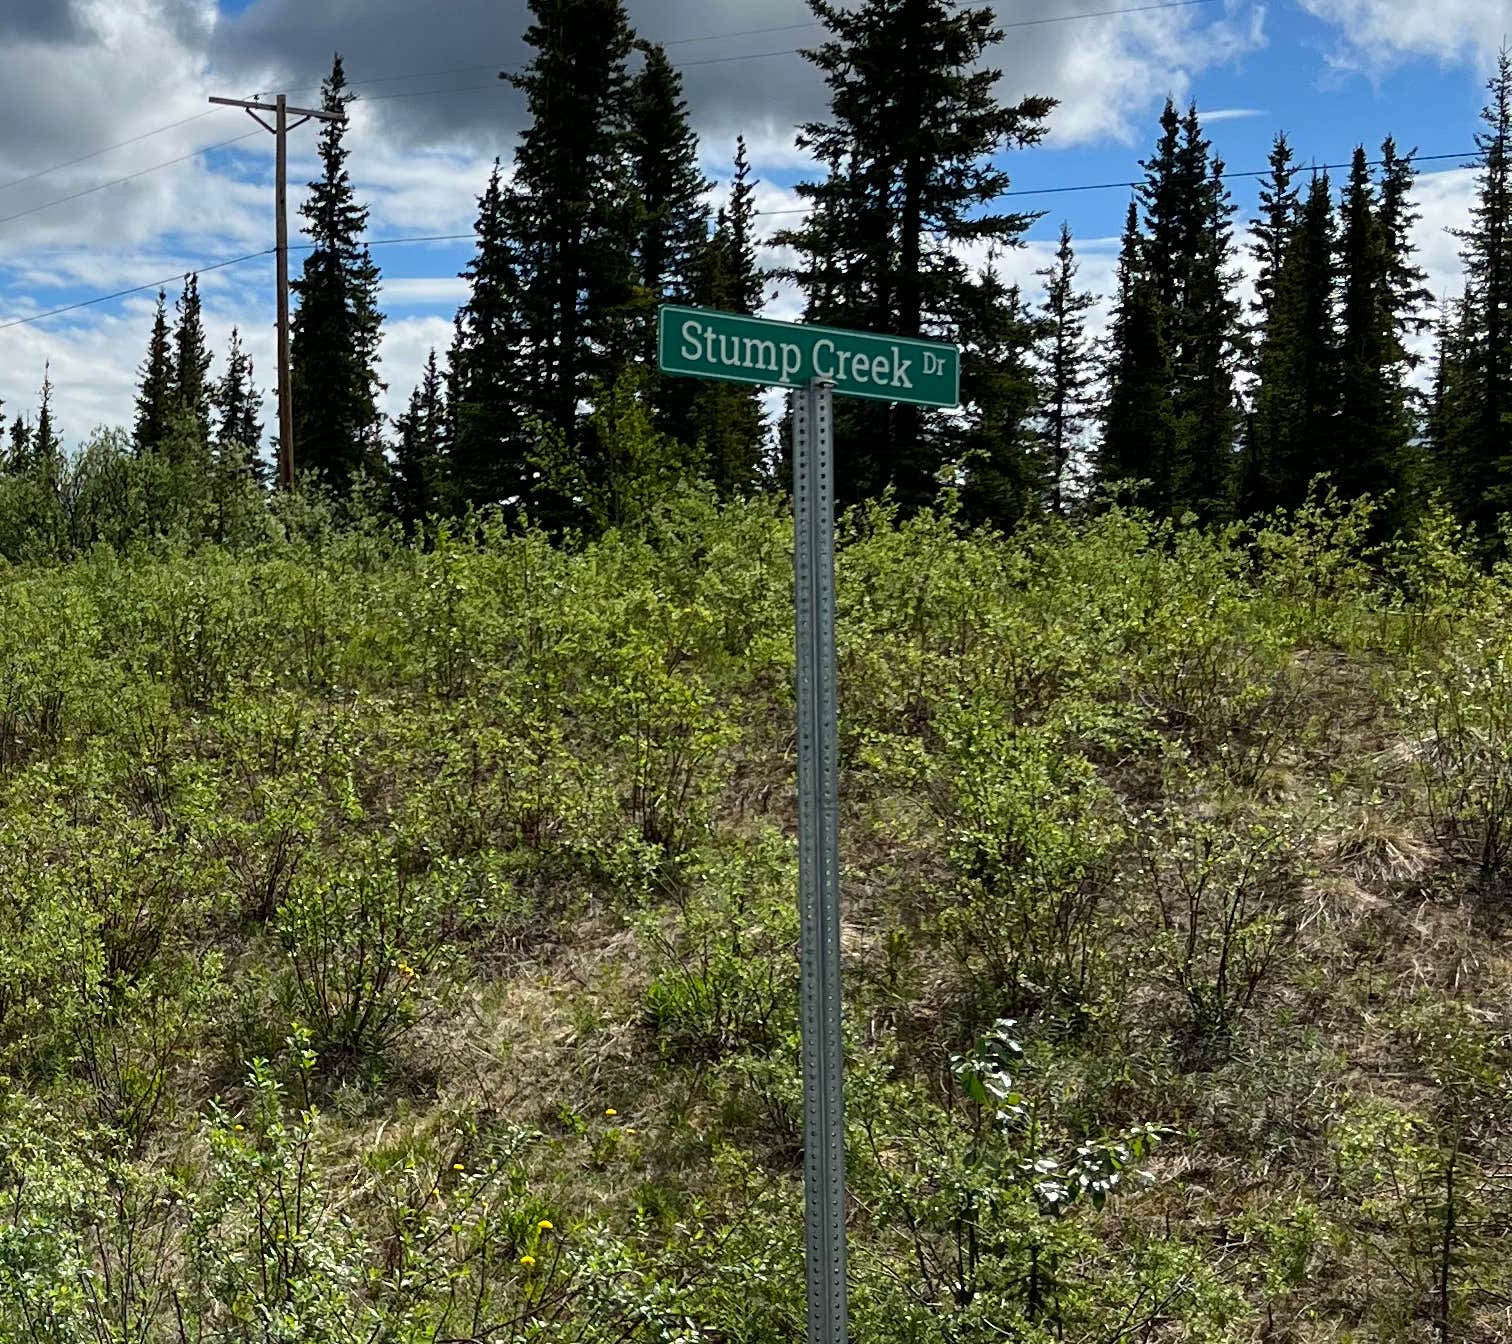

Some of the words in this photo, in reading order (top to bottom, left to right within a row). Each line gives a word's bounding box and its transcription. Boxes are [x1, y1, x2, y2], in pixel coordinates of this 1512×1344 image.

[681, 320, 801, 383] Stump
[812, 339, 913, 388] Creek
[922, 351, 946, 376] Dr
